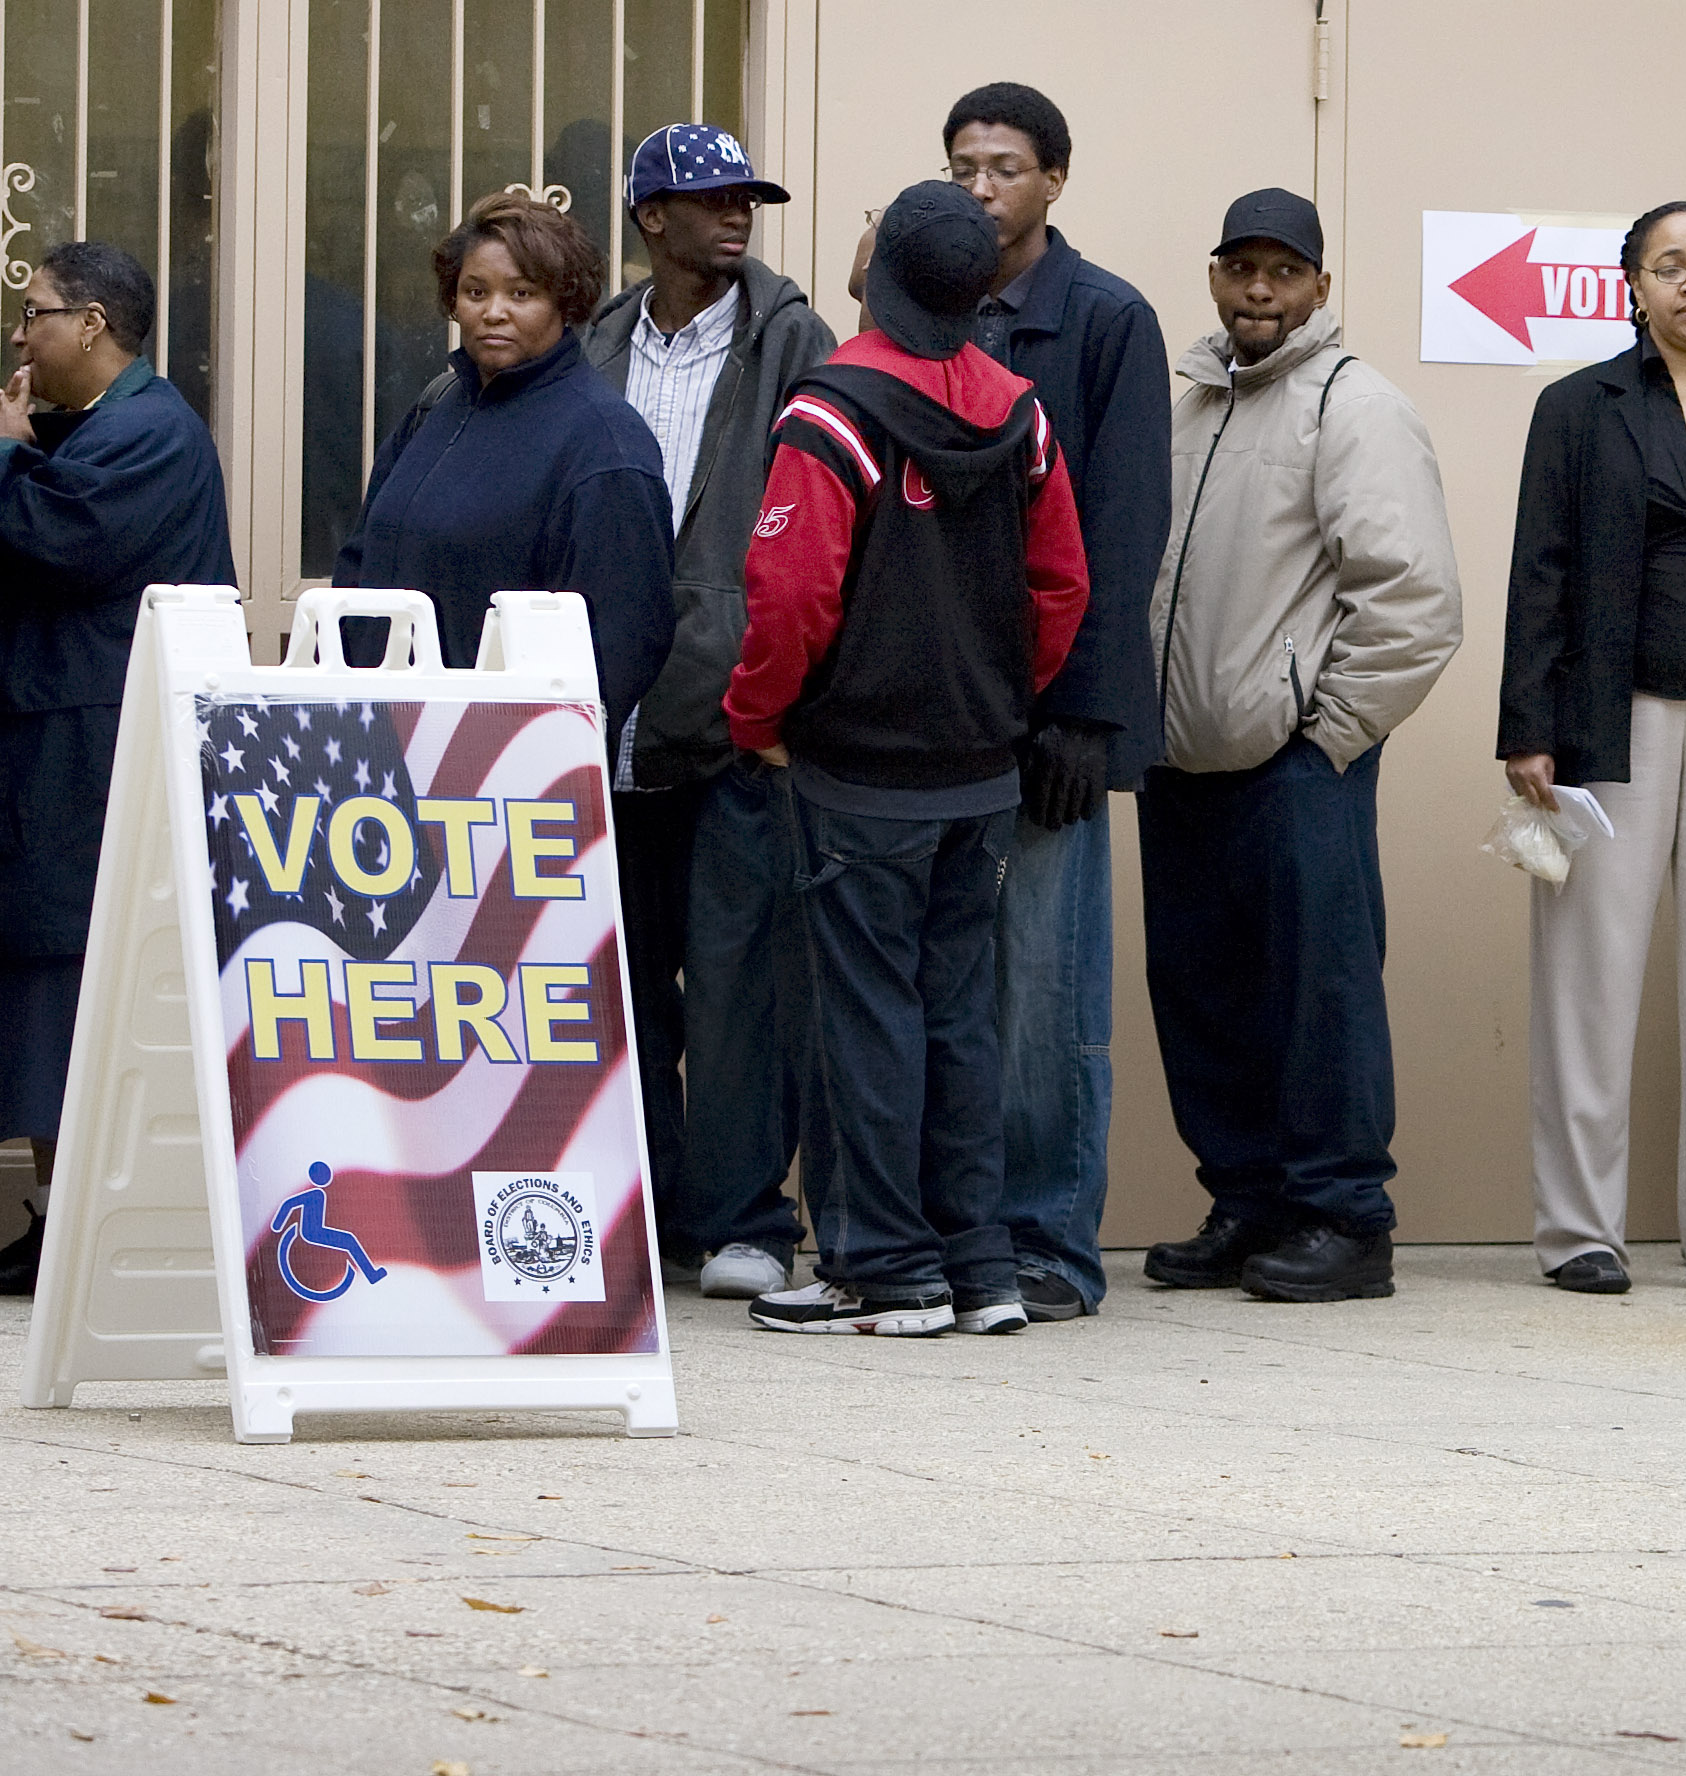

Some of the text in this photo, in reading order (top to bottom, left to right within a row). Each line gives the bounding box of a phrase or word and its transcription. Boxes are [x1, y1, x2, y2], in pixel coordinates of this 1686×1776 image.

[228, 792, 587, 900] VOTE
[243, 957, 601, 1064] HERE
[484, 1178, 594, 1266] BOARD OF ELECTIONS AND ETHICS
